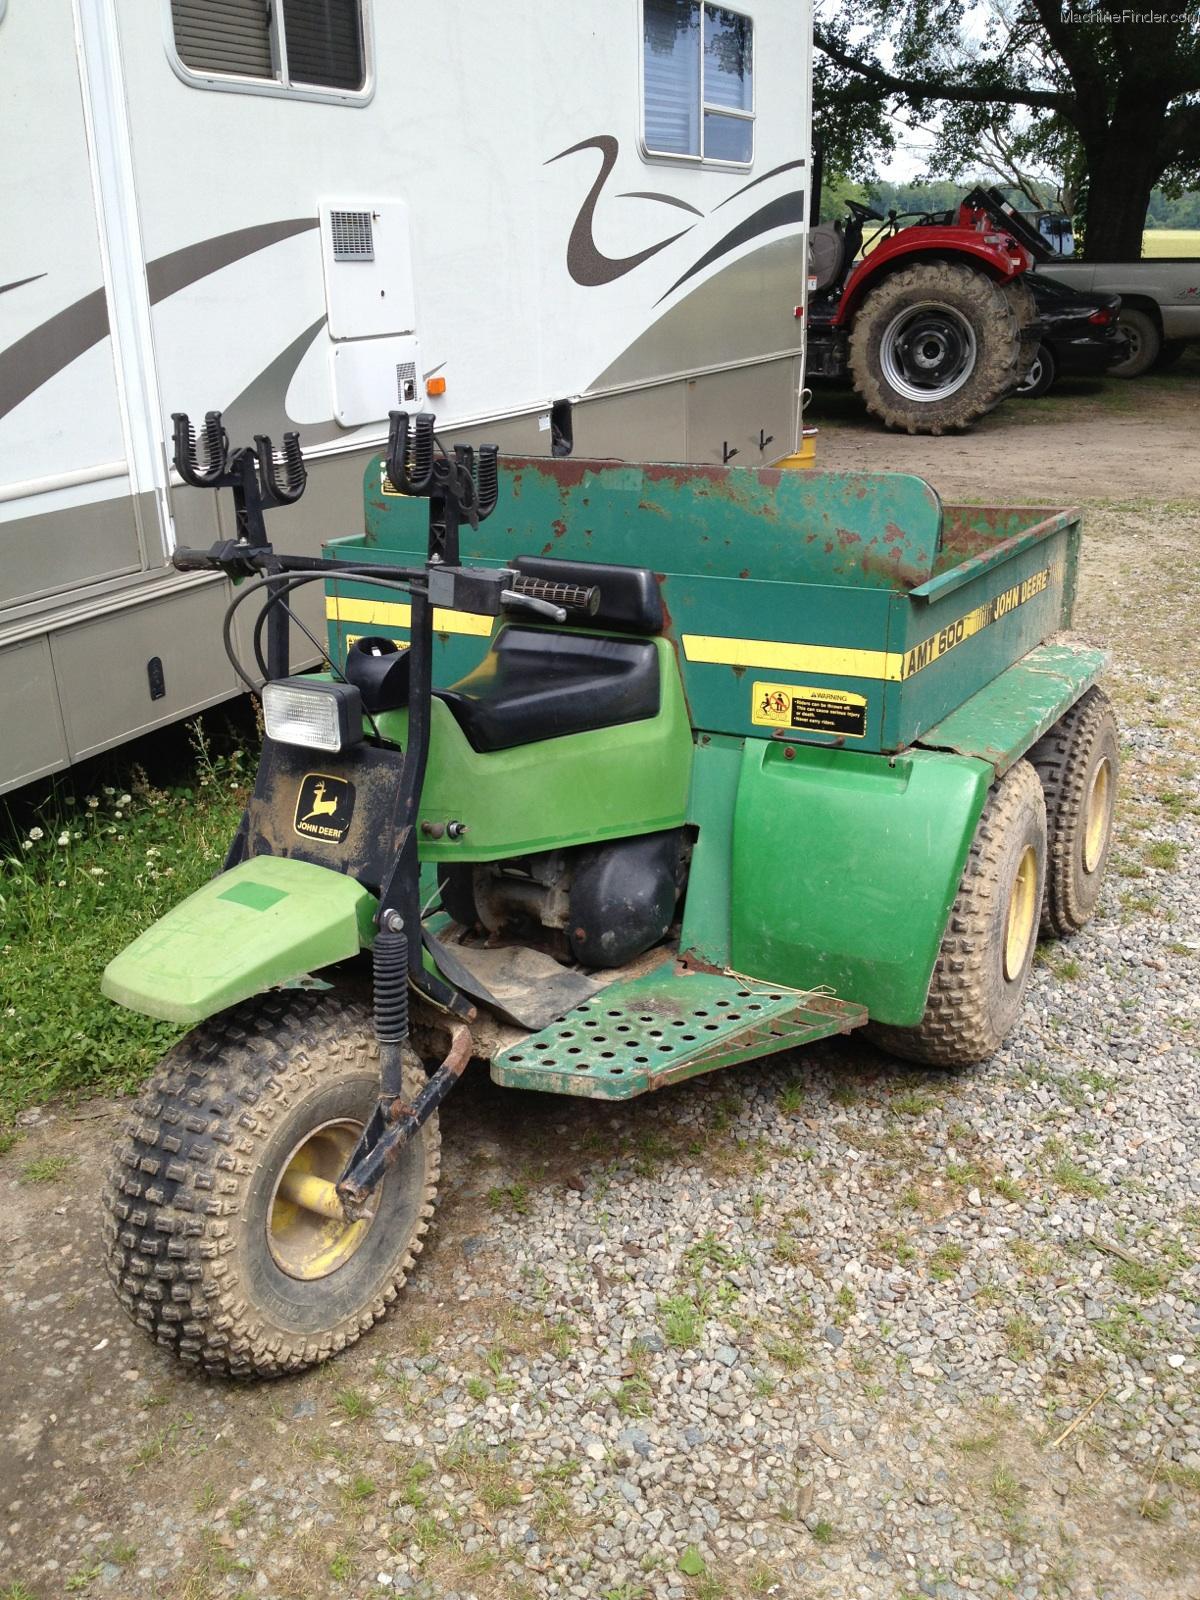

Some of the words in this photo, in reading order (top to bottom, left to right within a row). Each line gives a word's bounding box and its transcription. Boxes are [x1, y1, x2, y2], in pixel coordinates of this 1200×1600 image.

[994, 586, 1020, 620] JOHN
[1021, 571, 1048, 603] DEERE
[907, 636, 935, 676] AMT
[938, 620, 965, 655] 600
[817, 692, 848, 701] WARNING
[297, 821, 318, 833] JOHN
